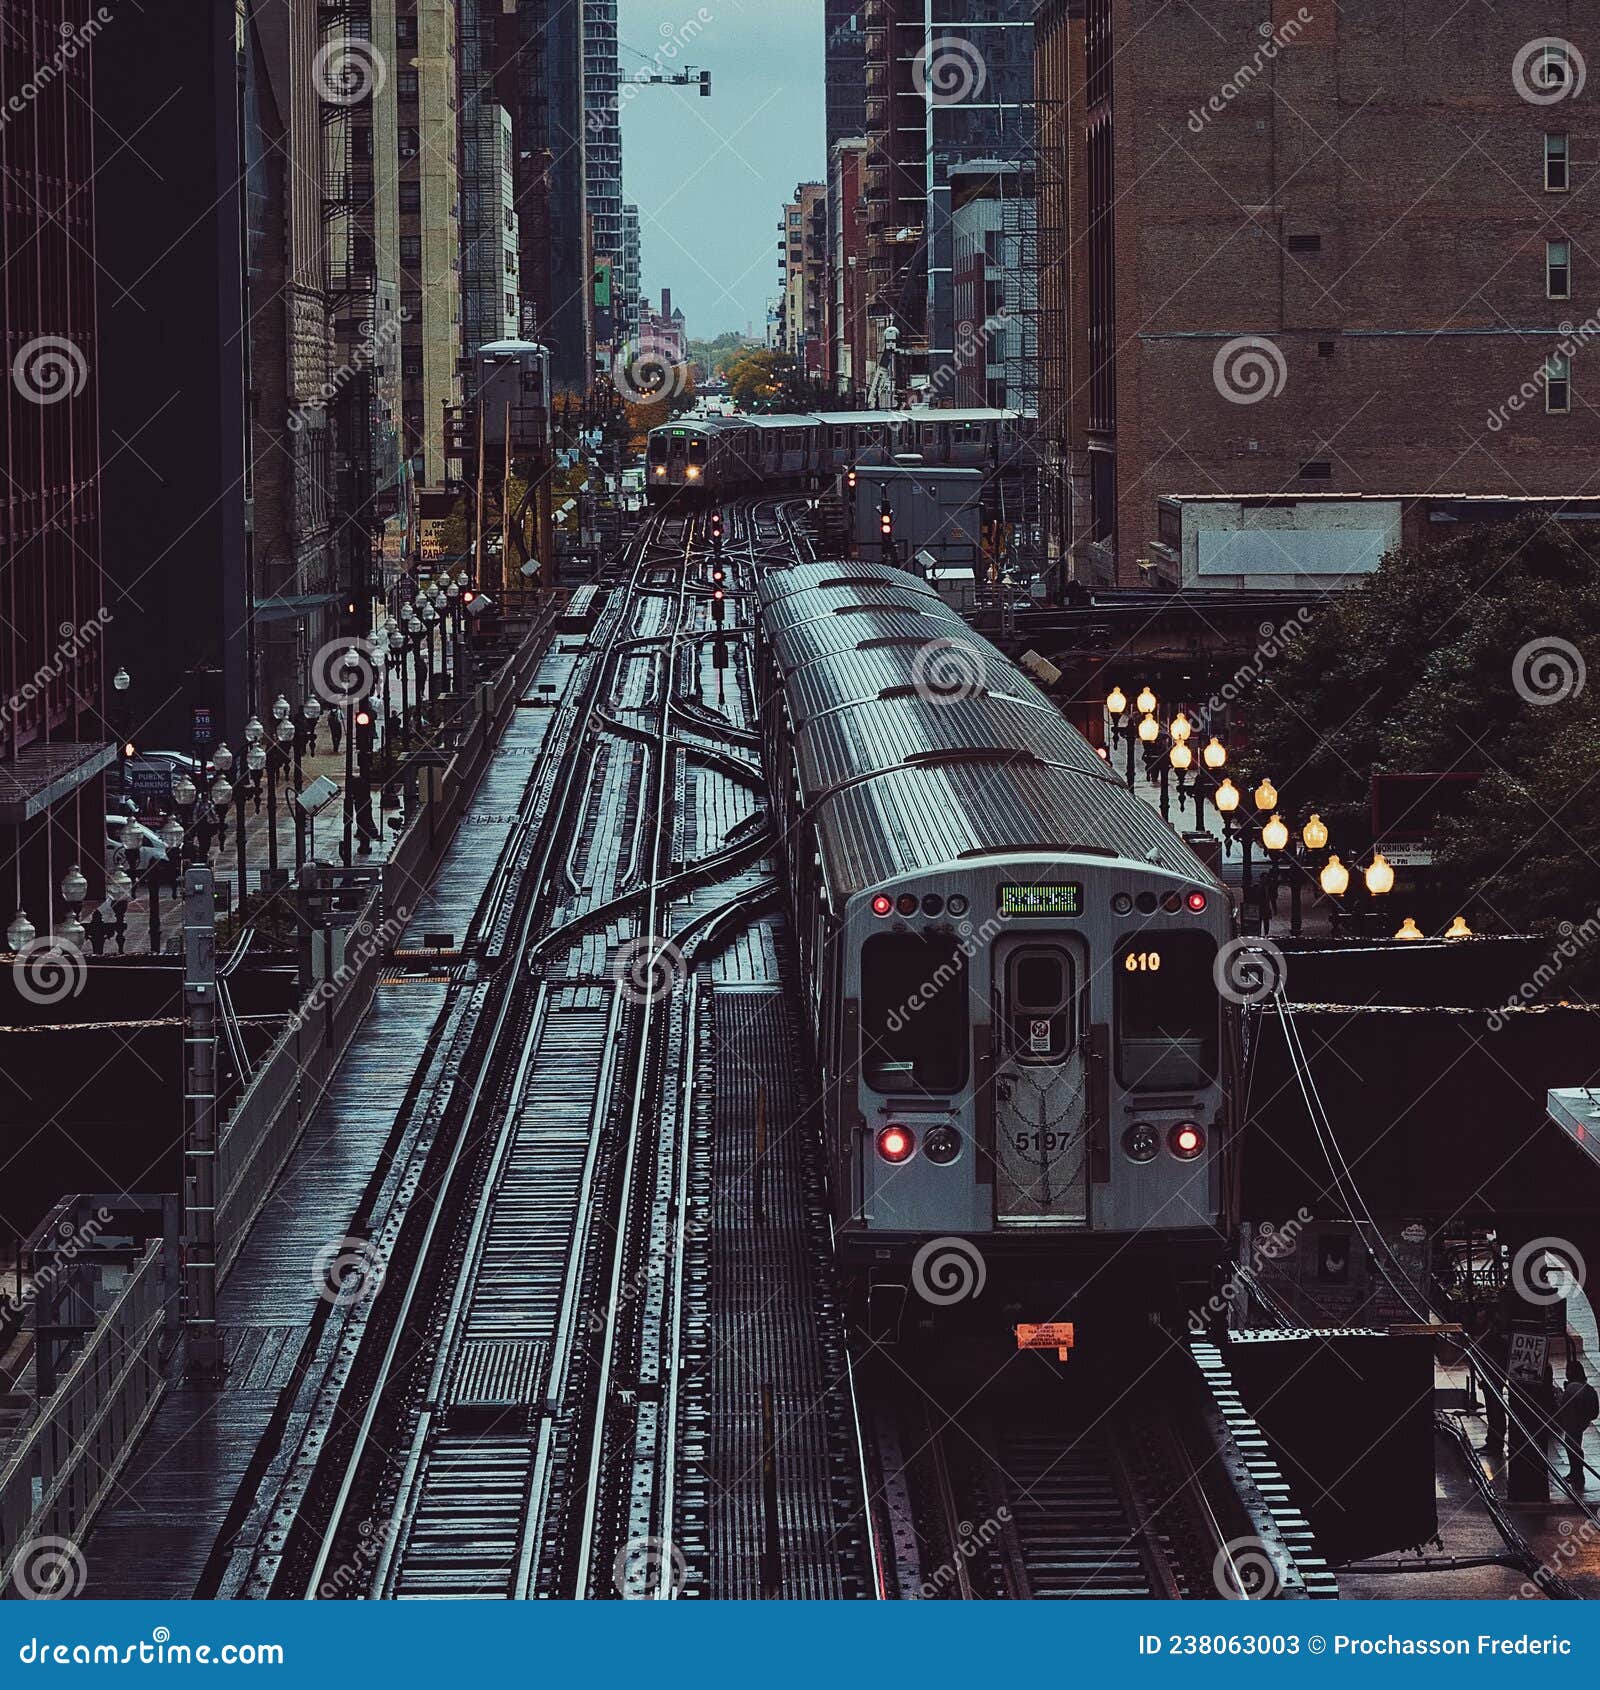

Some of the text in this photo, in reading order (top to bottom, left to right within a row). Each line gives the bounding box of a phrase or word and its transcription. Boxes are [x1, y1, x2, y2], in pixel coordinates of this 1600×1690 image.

[1375, 844, 1411, 853] MORNING
[1125, 952, 1161, 971] 610
[1015, 1132, 1071, 1151] 5197
